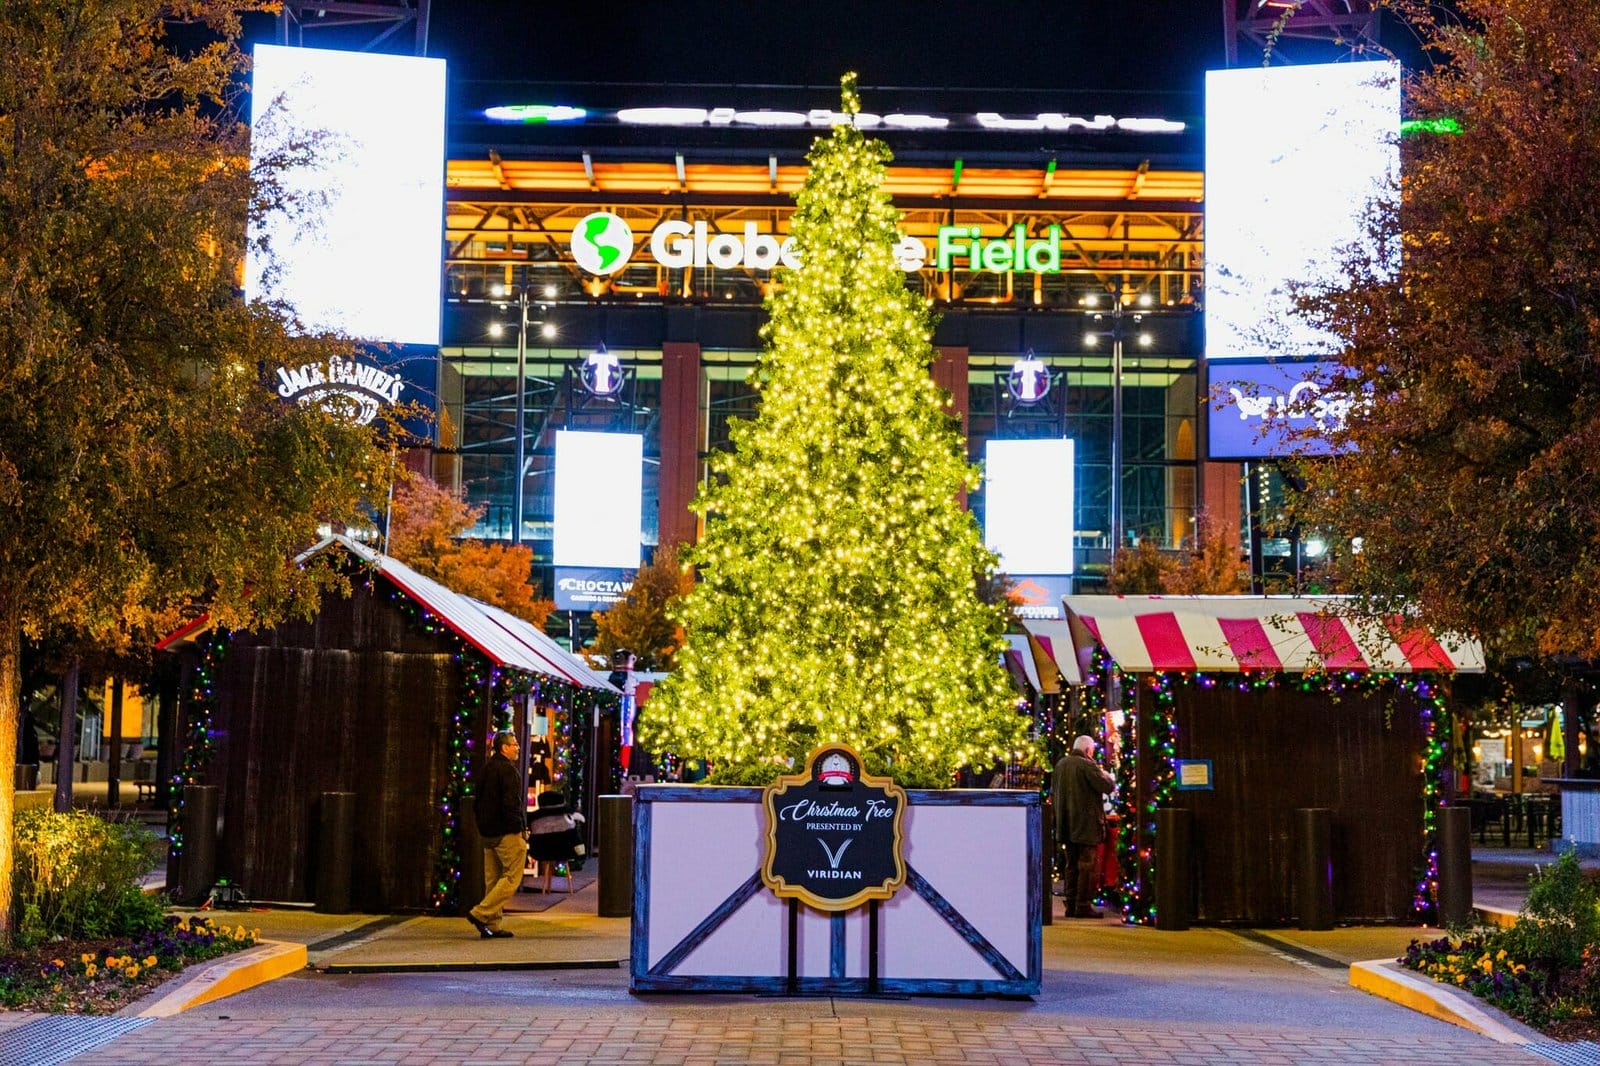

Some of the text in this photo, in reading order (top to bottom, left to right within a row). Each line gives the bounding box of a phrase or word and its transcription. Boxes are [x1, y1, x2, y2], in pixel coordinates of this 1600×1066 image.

[937, 223, 1061, 273] Field
[277, 361, 327, 398] JACK
[564, 578, 634, 593] CHOCTAW
[780, 799, 894, 822] Christmas Tree
[806, 822, 863, 831] PRESENTED BY
[807, 869, 862, 879] VIRIDIAN
